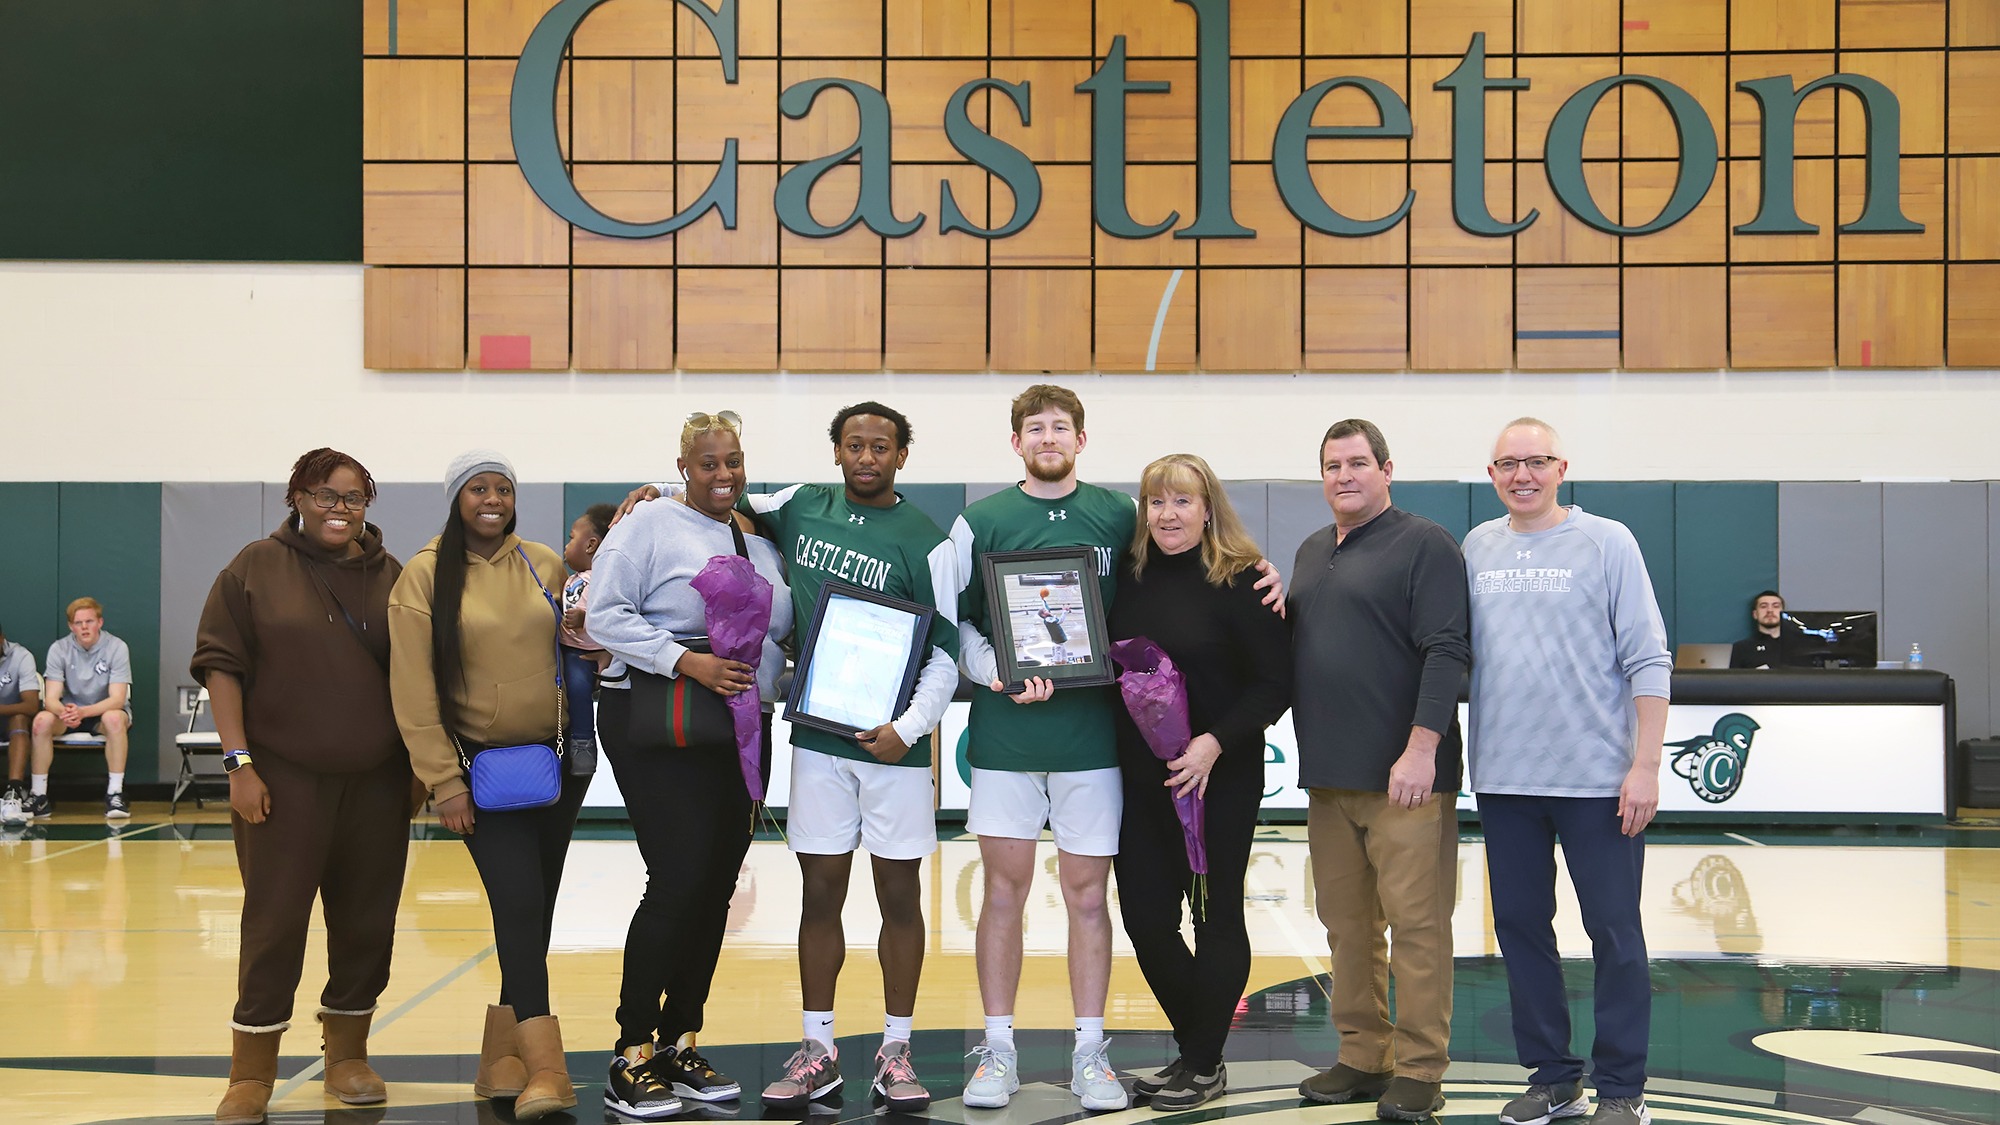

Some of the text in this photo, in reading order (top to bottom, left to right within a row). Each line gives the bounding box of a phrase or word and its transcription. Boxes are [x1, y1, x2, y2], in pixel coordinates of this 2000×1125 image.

[509, 0, 1926, 241] Castleton
[795, 533, 893, 592] CASTLETON
[1476, 568, 1573, 581] CASTLETON
[1473, 577, 1572, 595] BASKETBALL
[1709, 754, 1734, 789] C
